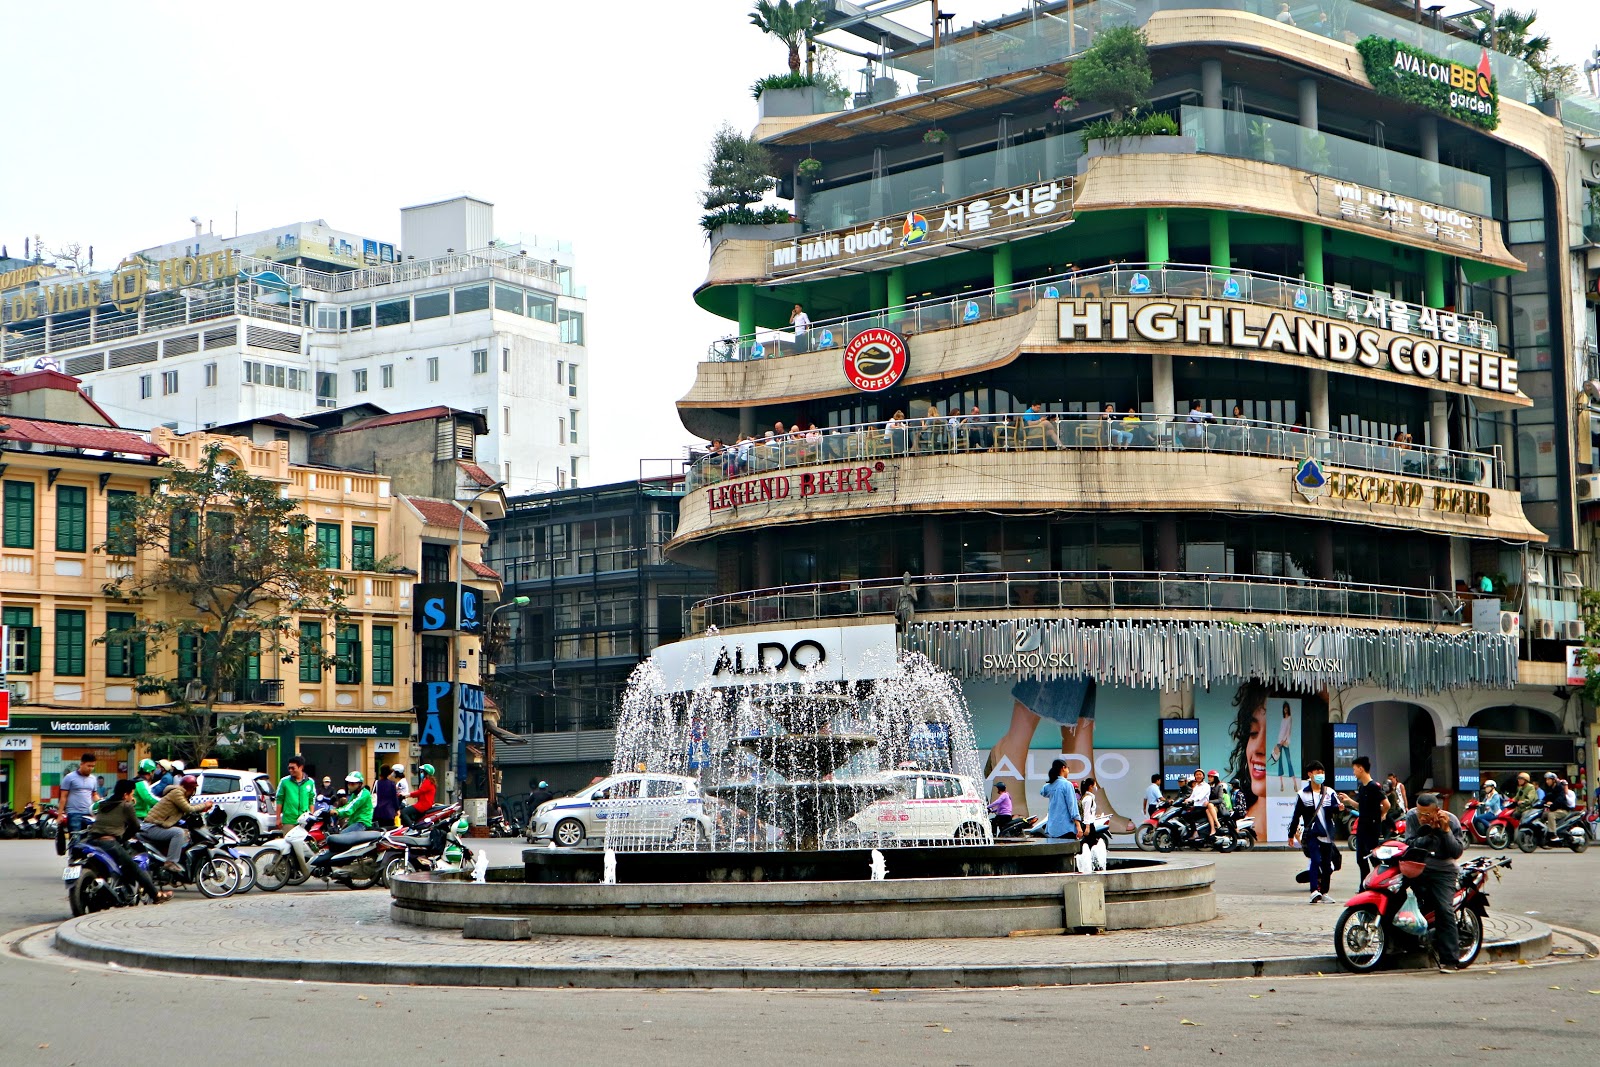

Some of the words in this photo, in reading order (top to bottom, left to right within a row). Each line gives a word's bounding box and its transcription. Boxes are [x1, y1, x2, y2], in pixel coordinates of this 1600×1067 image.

[1394, 51, 1449, 84] AVALON
[1450, 91, 1492, 115] garden
[938, 199, 994, 233] 서울
[1001, 182, 1062, 218] 식당
[1334, 183, 1362, 202] MÌ
[1368, 191, 1414, 214] HÀN
[774, 241, 797, 267] MÌ
[802, 233, 840, 262] HÀN
[844, 221, 894, 254] QUỐC
[0, 266, 36, 290] OTEL
[11, 292, 38, 322] DE
[43, 279, 101, 314] VILLE
[159, 249, 239, 290] HOTEL
[1363, 297, 1410, 334] 서울
[1418, 307, 1461, 343] 식당
[846, 332, 902, 362] HIGHLANDS
[1058, 301, 1381, 368] HIGHLANDS
[1388, 336, 1519, 393] COFFEE
[854, 370, 898, 389] COFFEE
[706, 475, 790, 511] LEGEND
[1329, 471, 1425, 508] LEGEND
[1433, 485, 1492, 518] BEER
[712, 639, 826, 676] ALDO
[983, 652, 1074, 669] SWAROVSKI
[1282, 656, 1343, 673] SWAROVSKI
[50, 720, 111, 731] Vietcombank
[328, 724, 377, 735] Vietcombank
[458, 711, 484, 742] SPA
[1164, 727, 1198, 735] SAMSUNG
[1334, 731, 1357, 739] SAMSUNG
[5, 739, 27, 747] ATM
[378, 742, 396, 750] ATM
[1505, 744, 1514, 755] BY
[1516, 745, 1528, 754] THE
[1529, 745, 1544, 754] WAY
[985, 752, 1130, 781] ALDO
